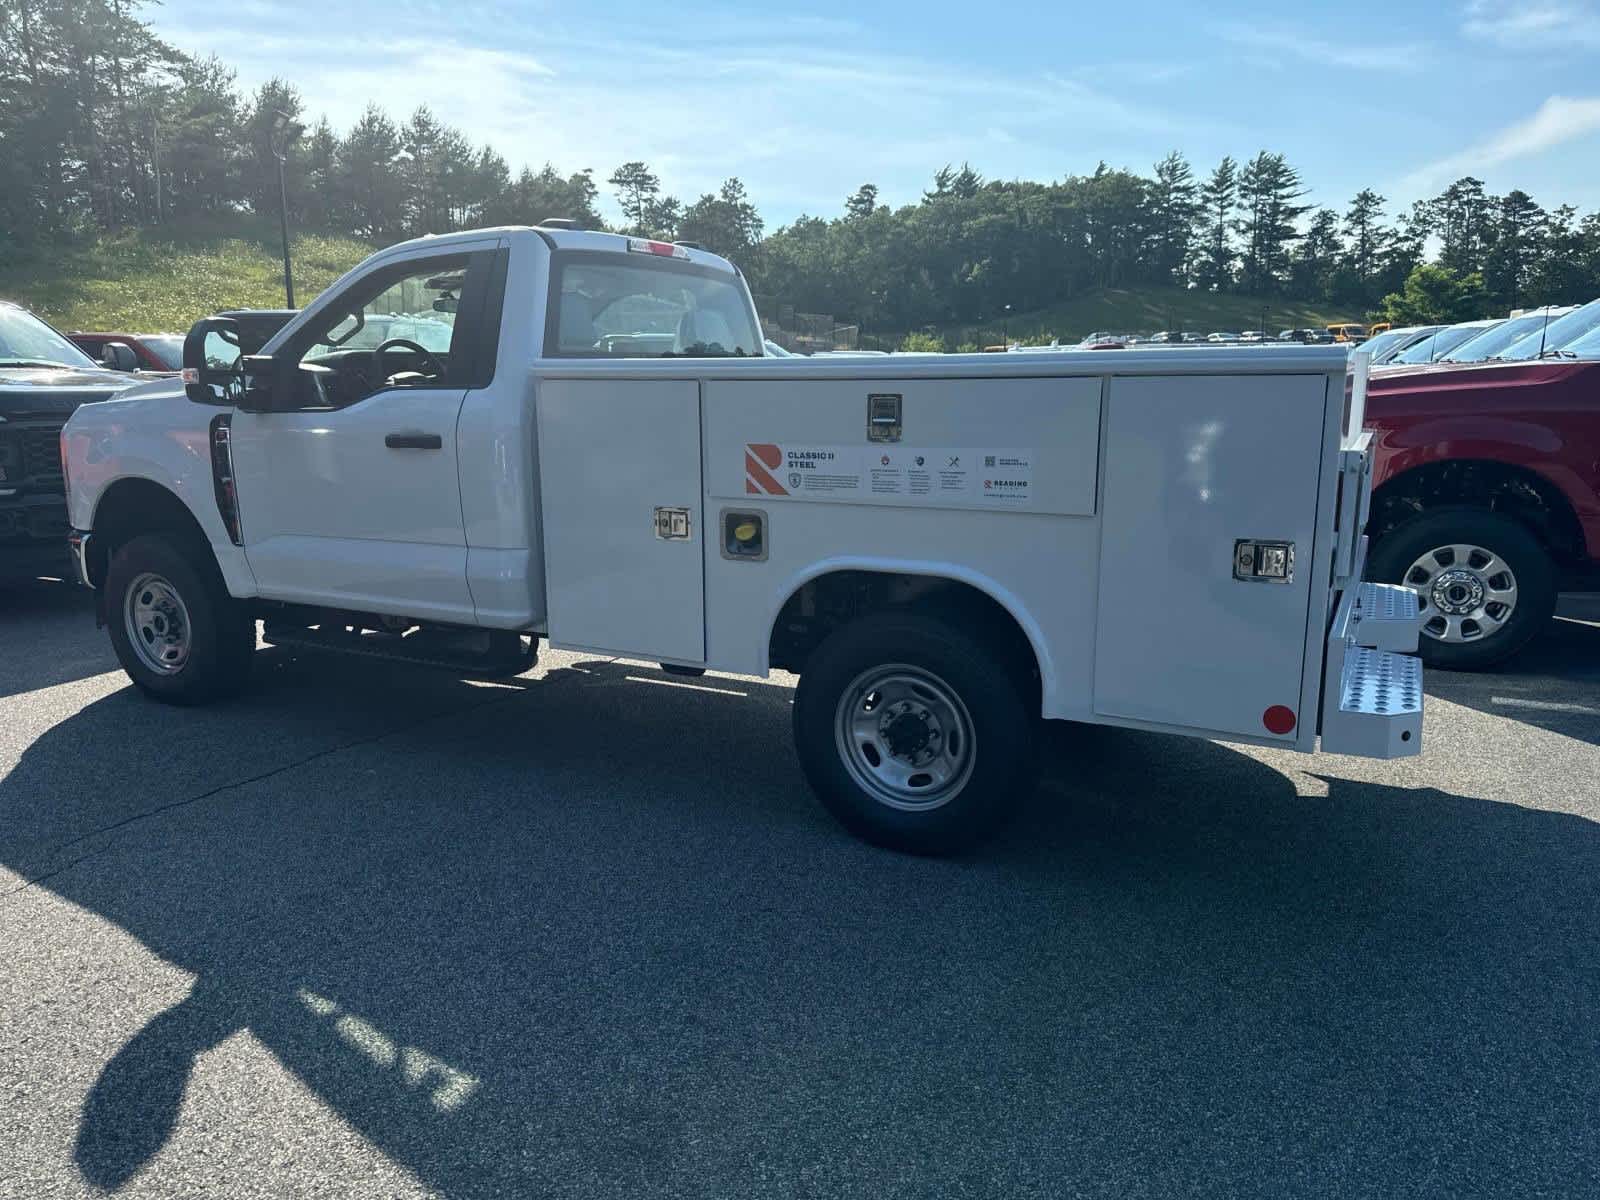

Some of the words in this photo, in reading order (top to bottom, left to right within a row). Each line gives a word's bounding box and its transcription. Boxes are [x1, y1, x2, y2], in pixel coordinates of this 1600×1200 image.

[787, 451, 826, 460] CLASSIC
[828, 452, 835, 461] II
[788, 461, 817, 469] STEEL
[994, 480, 1028, 488] READING
